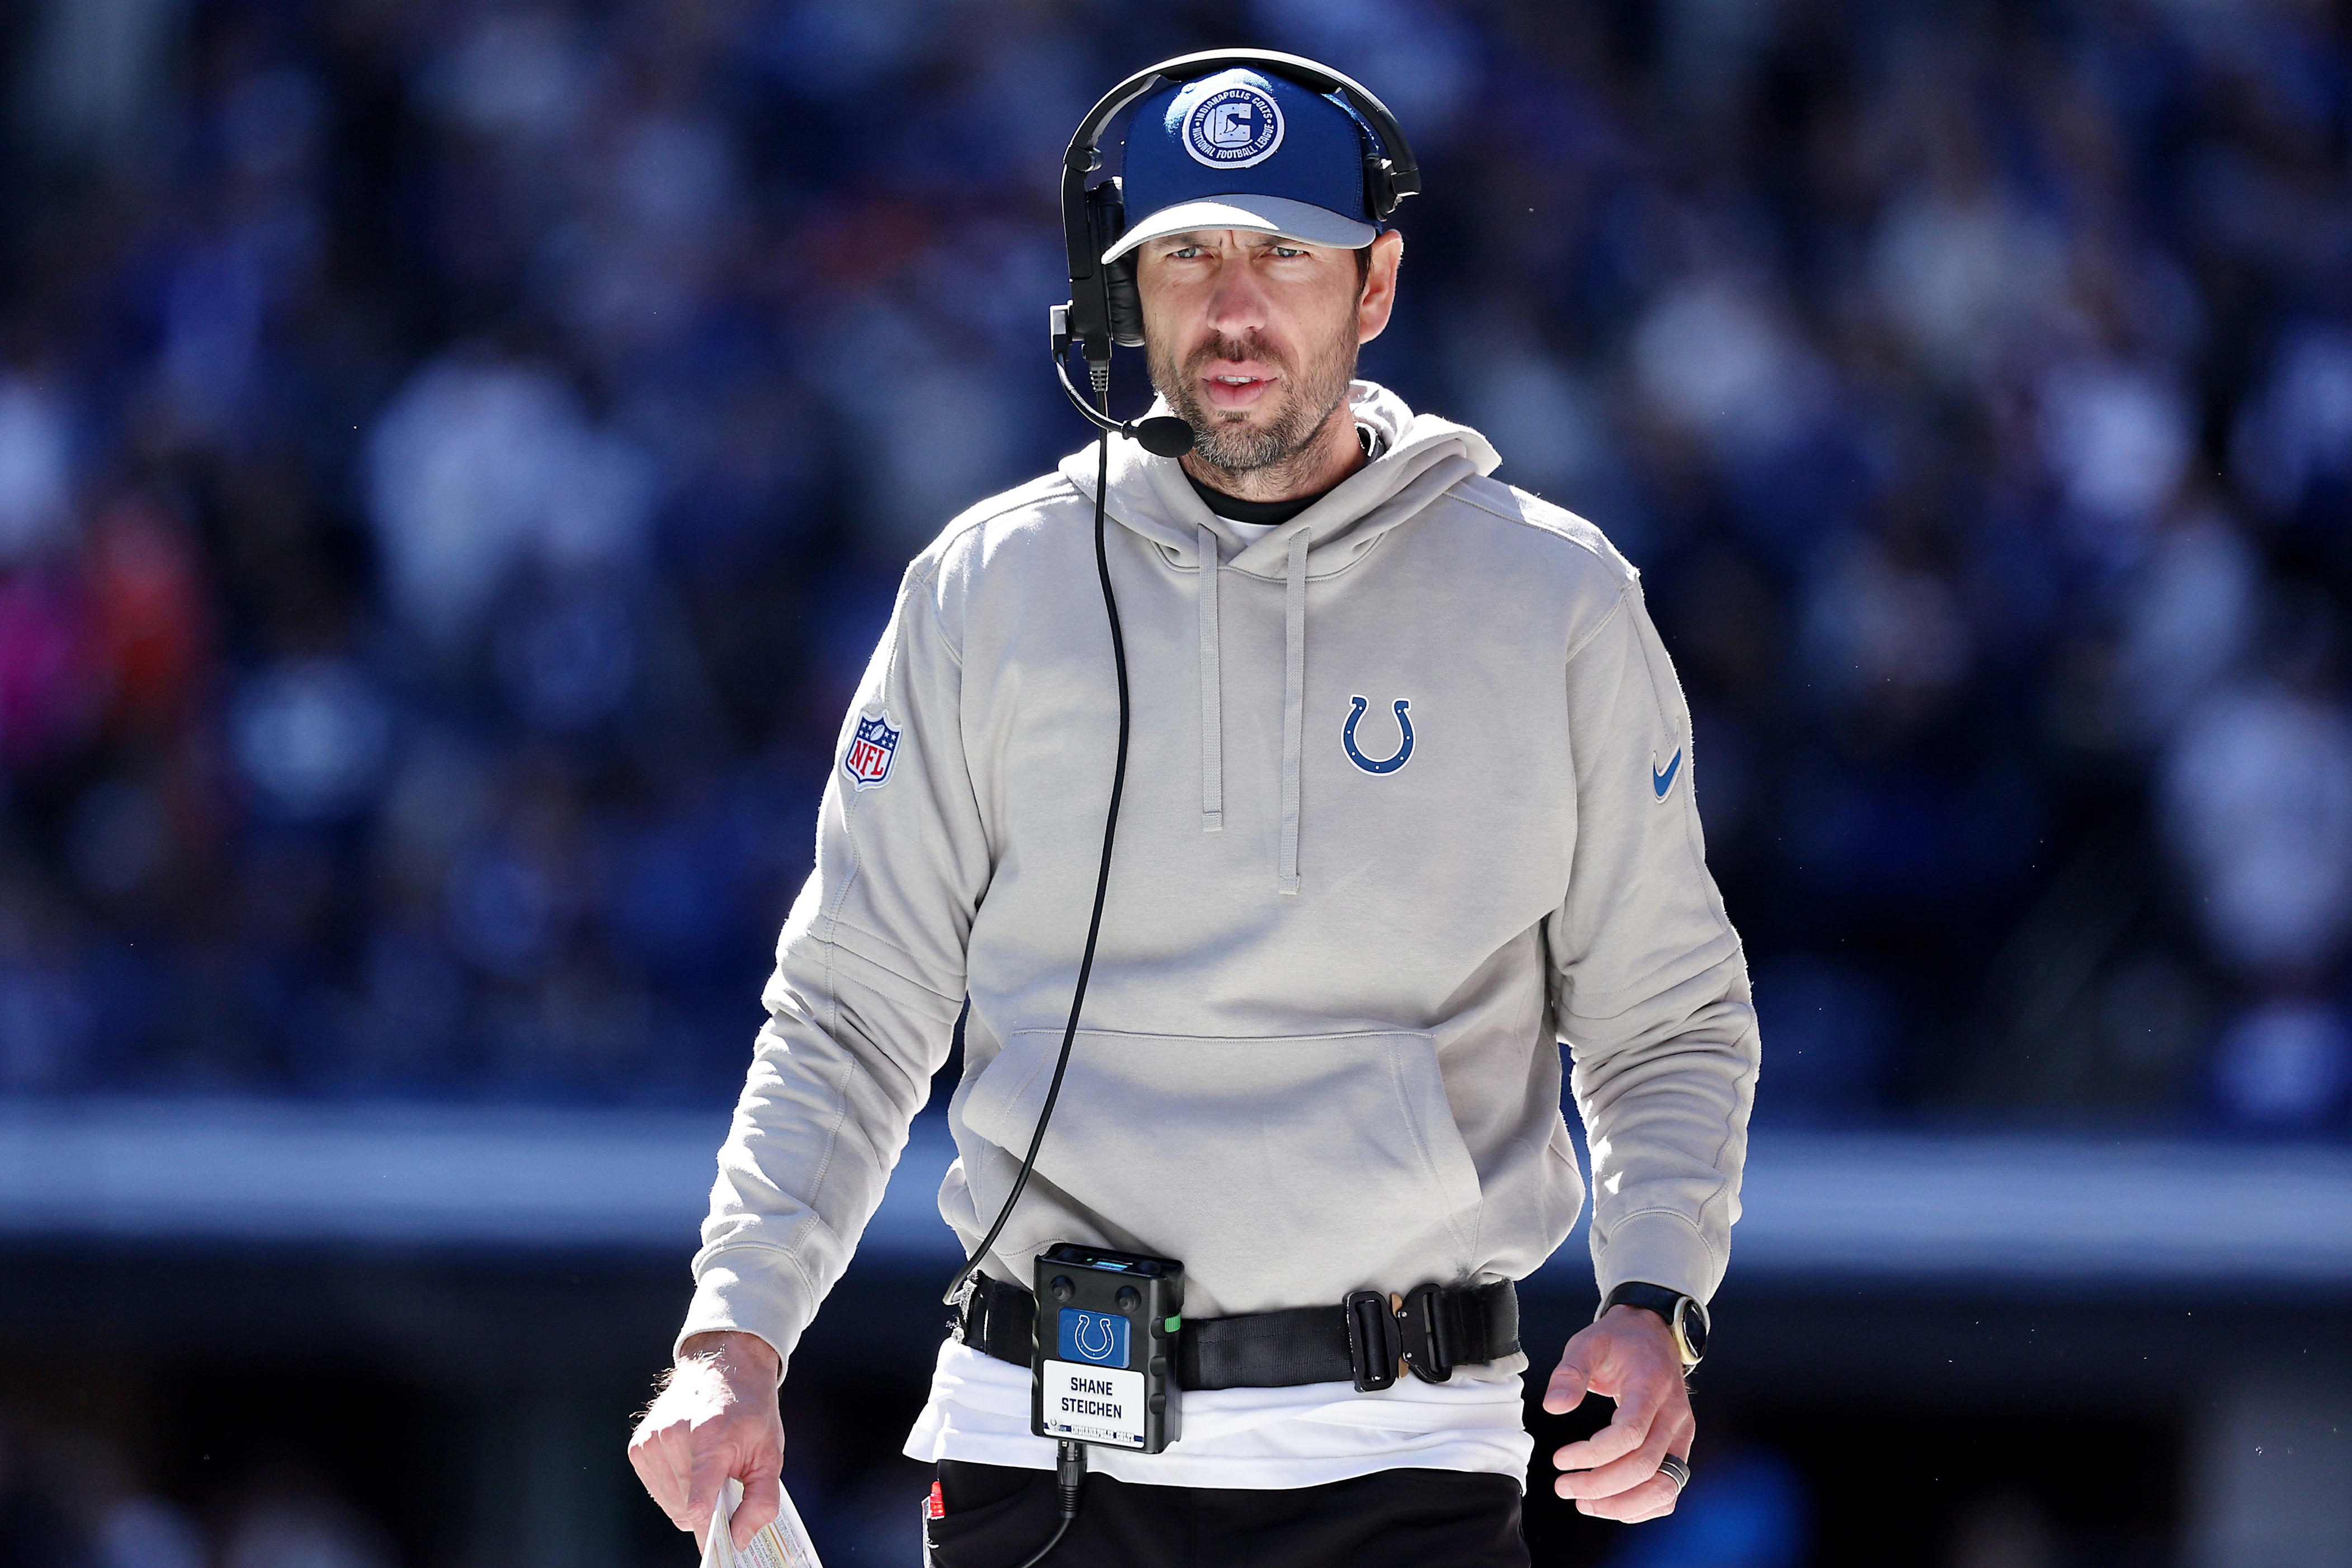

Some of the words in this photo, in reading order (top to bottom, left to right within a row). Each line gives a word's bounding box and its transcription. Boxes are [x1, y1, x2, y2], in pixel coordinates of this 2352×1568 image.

[1194, 91, 1251, 121] INDIANAPOLIS
[1251, 97, 1273, 119] COLTS
[1193, 127, 1216, 157] NATIONAL
[1216, 146, 1258, 159] FOOTBALL
[1255, 124, 1274, 149] LEAGUE
[849, 740, 885, 776] NFL
[1071, 1377, 1113, 1396] SHANE
[1062, 1397, 1122, 1419] STEICHEN
[1071, 1425, 1114, 1439] INDIANAPOLIS
[1116, 1431, 1135, 1443] COLTS
